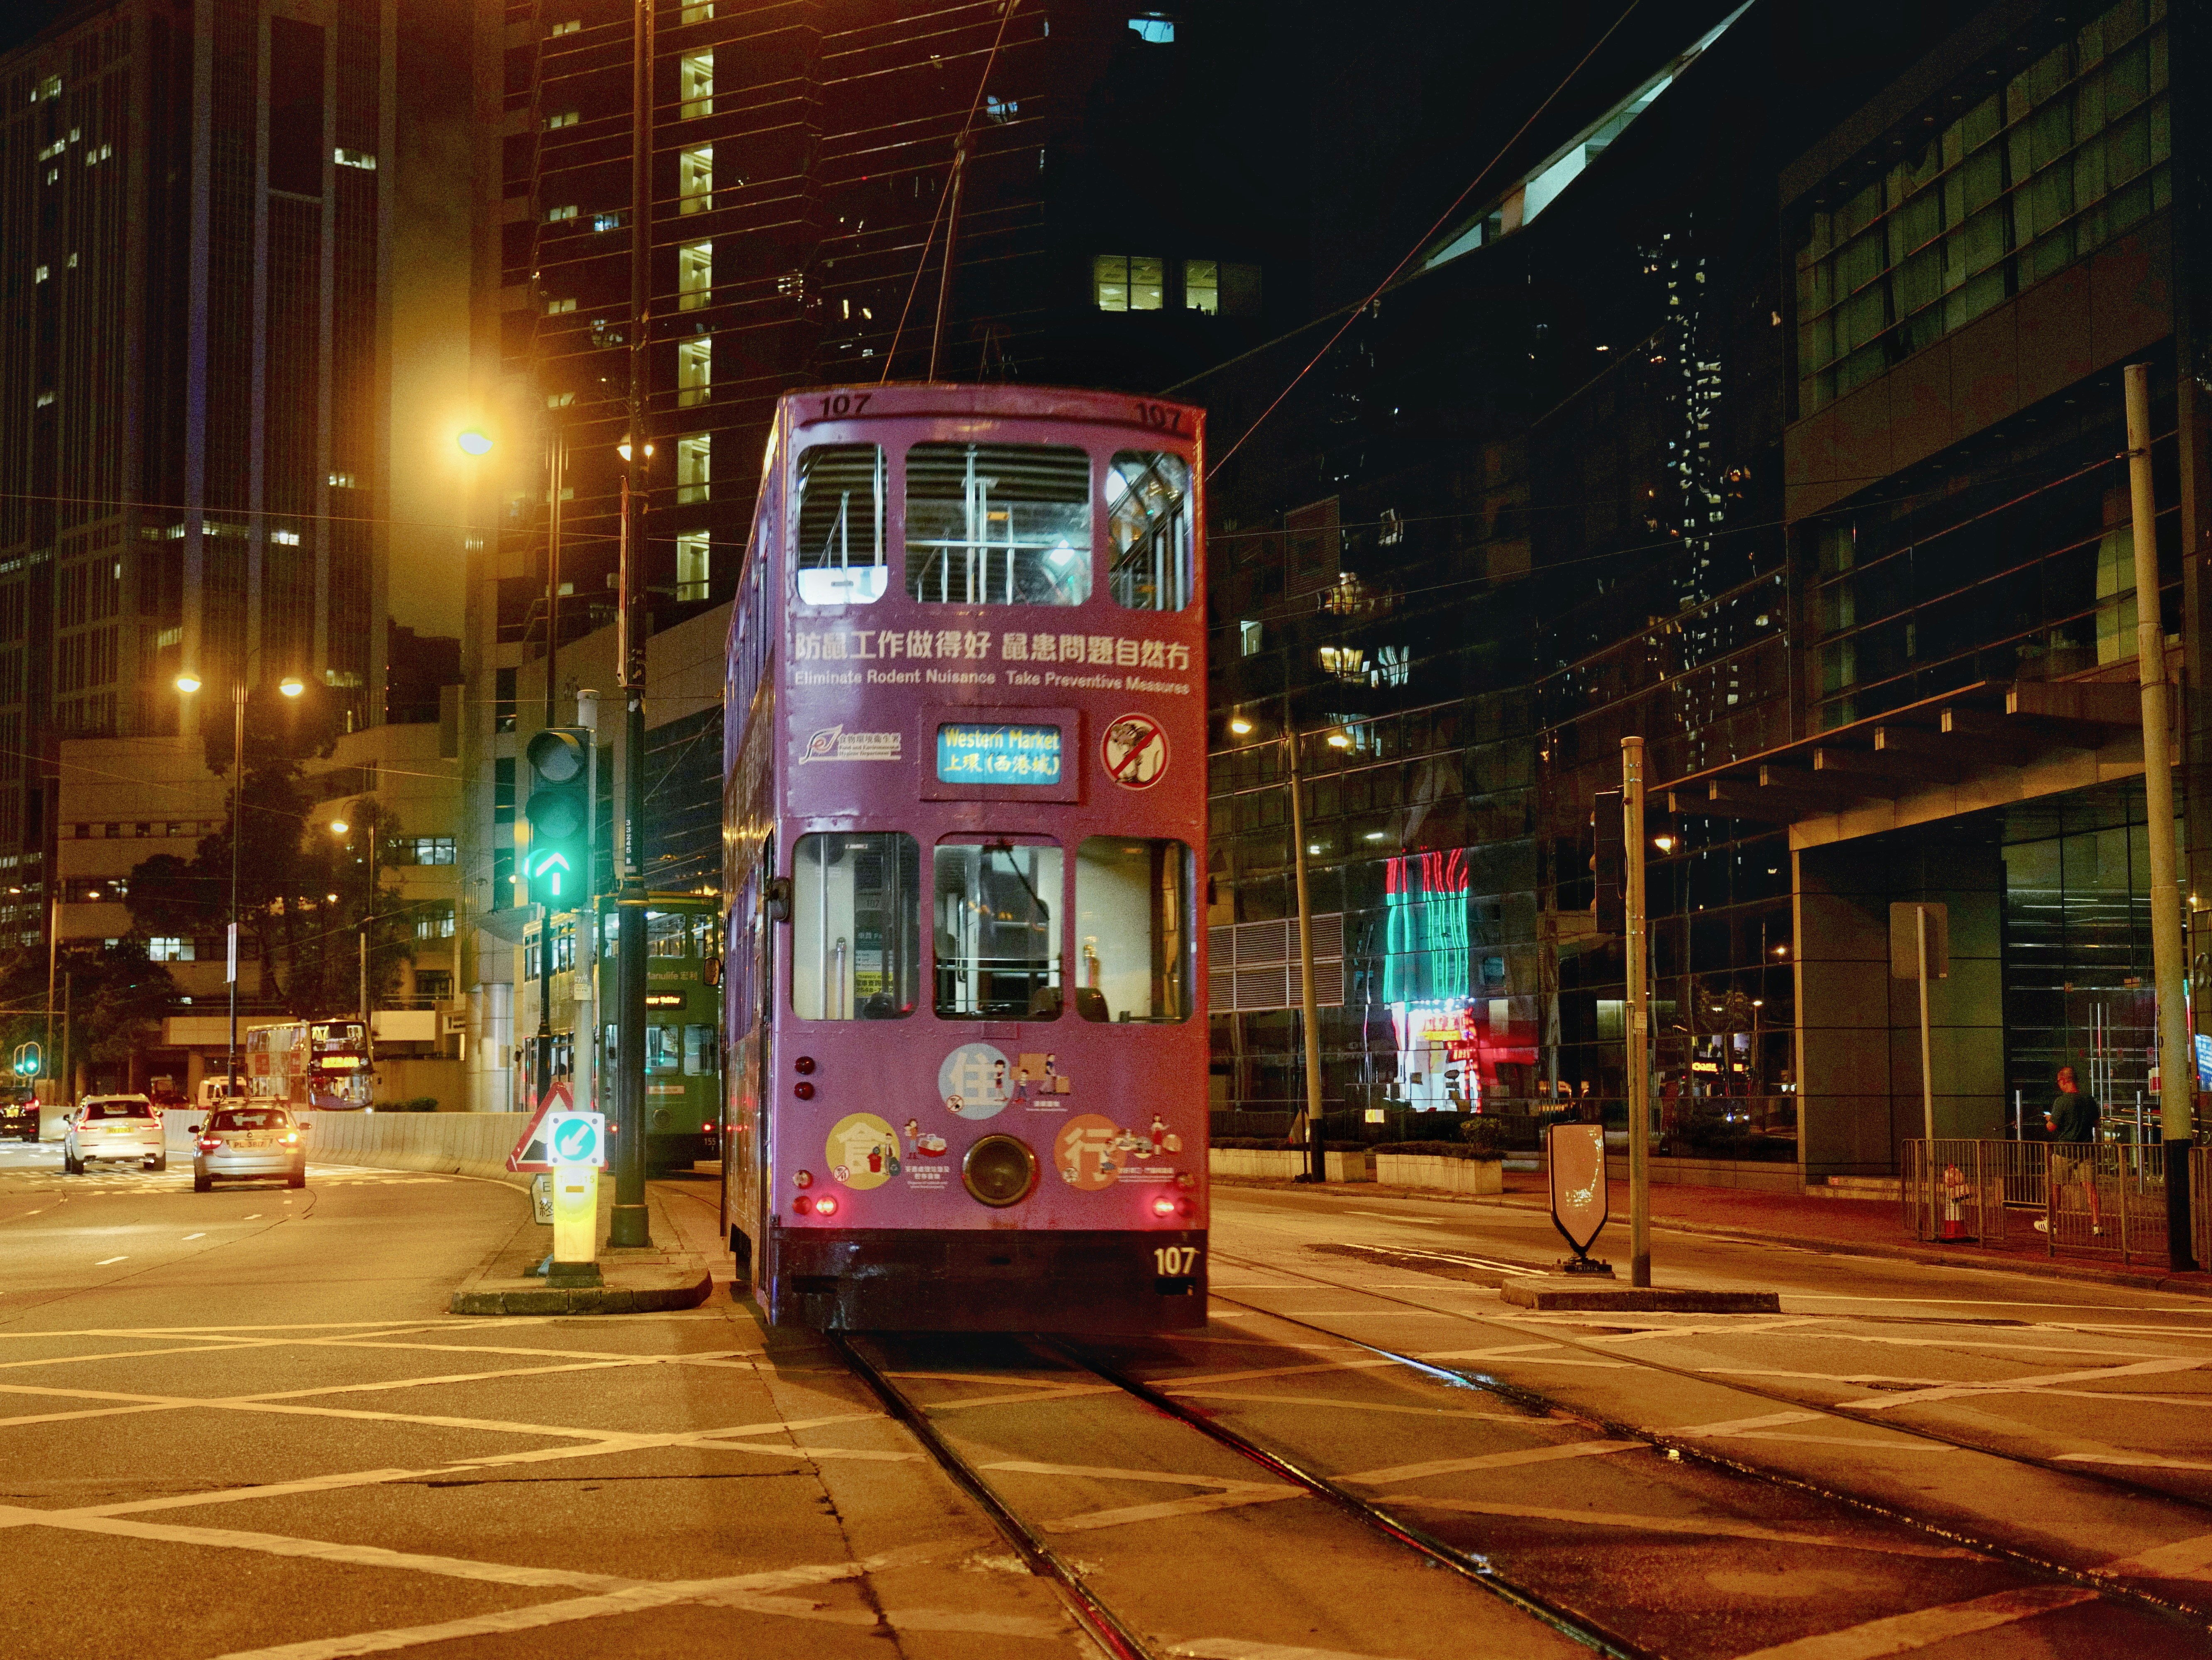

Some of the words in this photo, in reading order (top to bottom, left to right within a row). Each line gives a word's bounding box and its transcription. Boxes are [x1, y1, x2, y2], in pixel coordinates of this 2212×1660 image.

[820, 393, 872, 416] 107
[1136, 403, 1181, 427] 107
[795, 630, 992, 660] 防鼠工作做得好
[1002, 632, 1190, 670] 鼠患問題自然冇
[795, 671, 862, 685] Eliminate
[868, 670, 921, 684] Rodent
[926, 669, 996, 685] Nuisance
[1006, 670, 1040, 686] Take
[1045, 671, 1122, 689] Preventive
[1126, 676, 1190, 695] Measures
[945, 728, 1003, 747] Western
[1009, 730, 1059, 750] Market
[949, 1052, 1005, 1106] 住
[1064, 1127, 1114, 1182] 行
[539, 1199, 554, 1217] 終
[1154, 1246, 1197, 1275] 107
